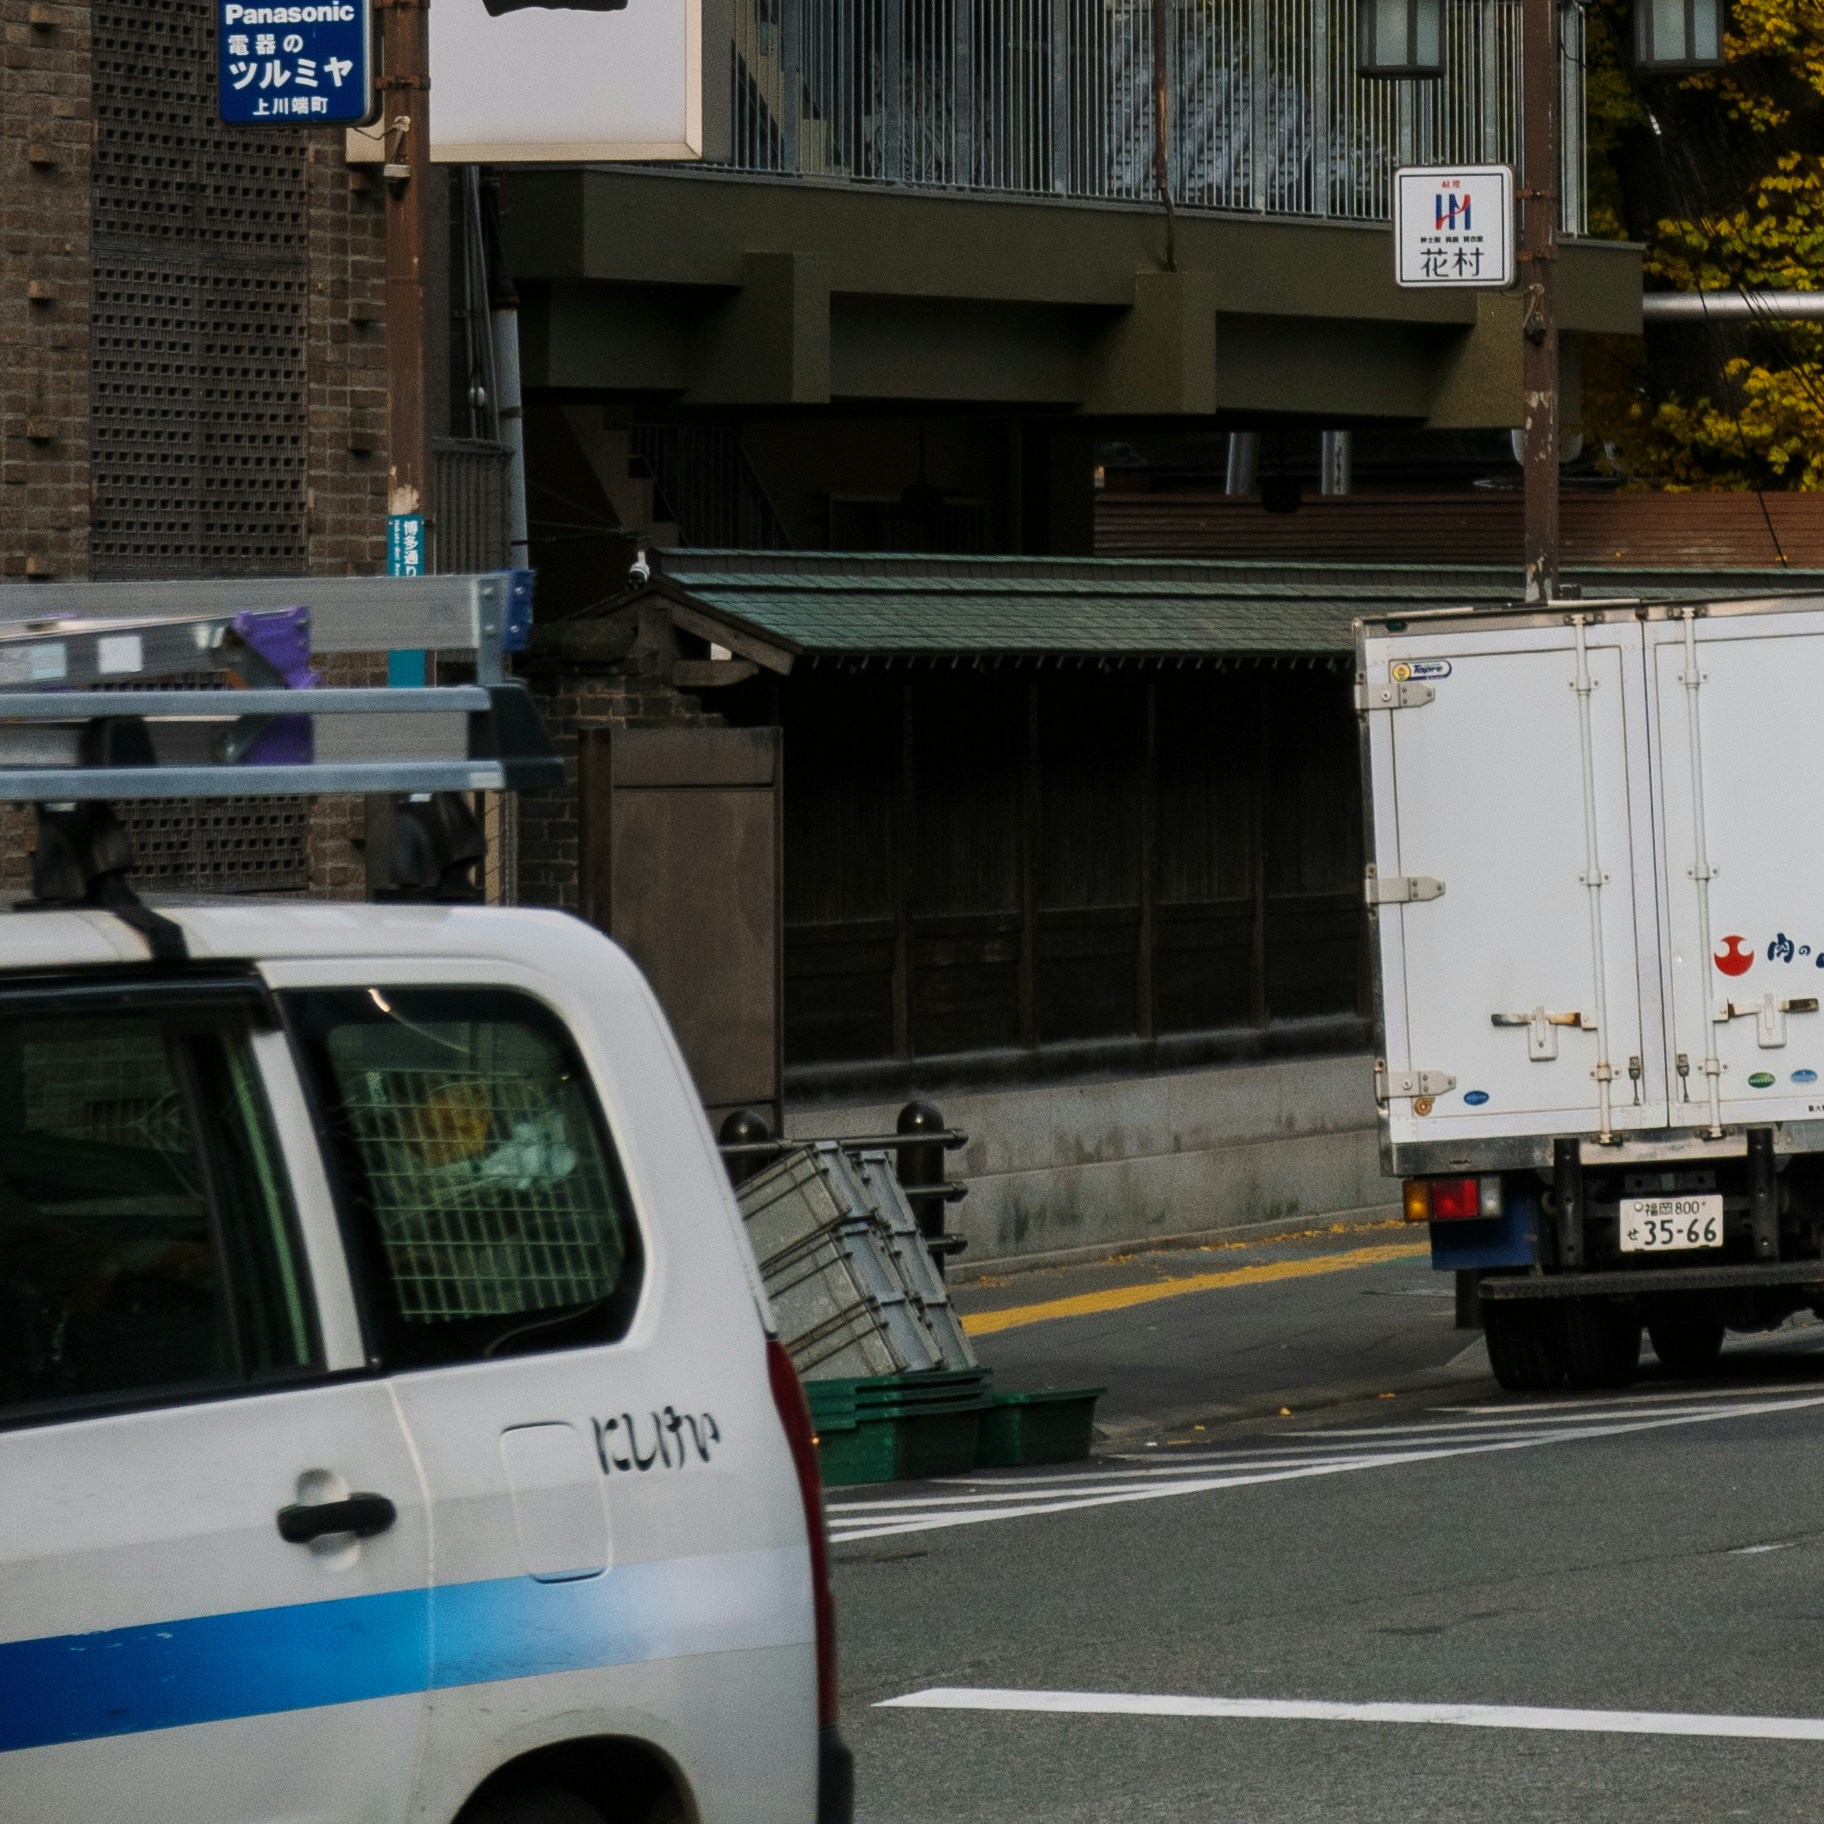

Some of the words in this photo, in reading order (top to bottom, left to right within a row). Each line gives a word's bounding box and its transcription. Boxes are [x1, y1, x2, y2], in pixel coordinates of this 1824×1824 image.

[225, 0, 355, 25] Panasonic
[228, 34, 304, 56] 電器の
[228, 57, 354, 91] ツルミヤ
[252, 96, 329, 116] 上川端町
[1420, 247, 1485, 278] 花村
[403, 520, 420, 577] 博多通り
[1645, 1202, 1673, 1217] 福岡
[1675, 1200, 1700, 1215] 800
[1627, 1228, 1639, 1241] せ
[1643, 1217, 1717, 1246] 35-66
